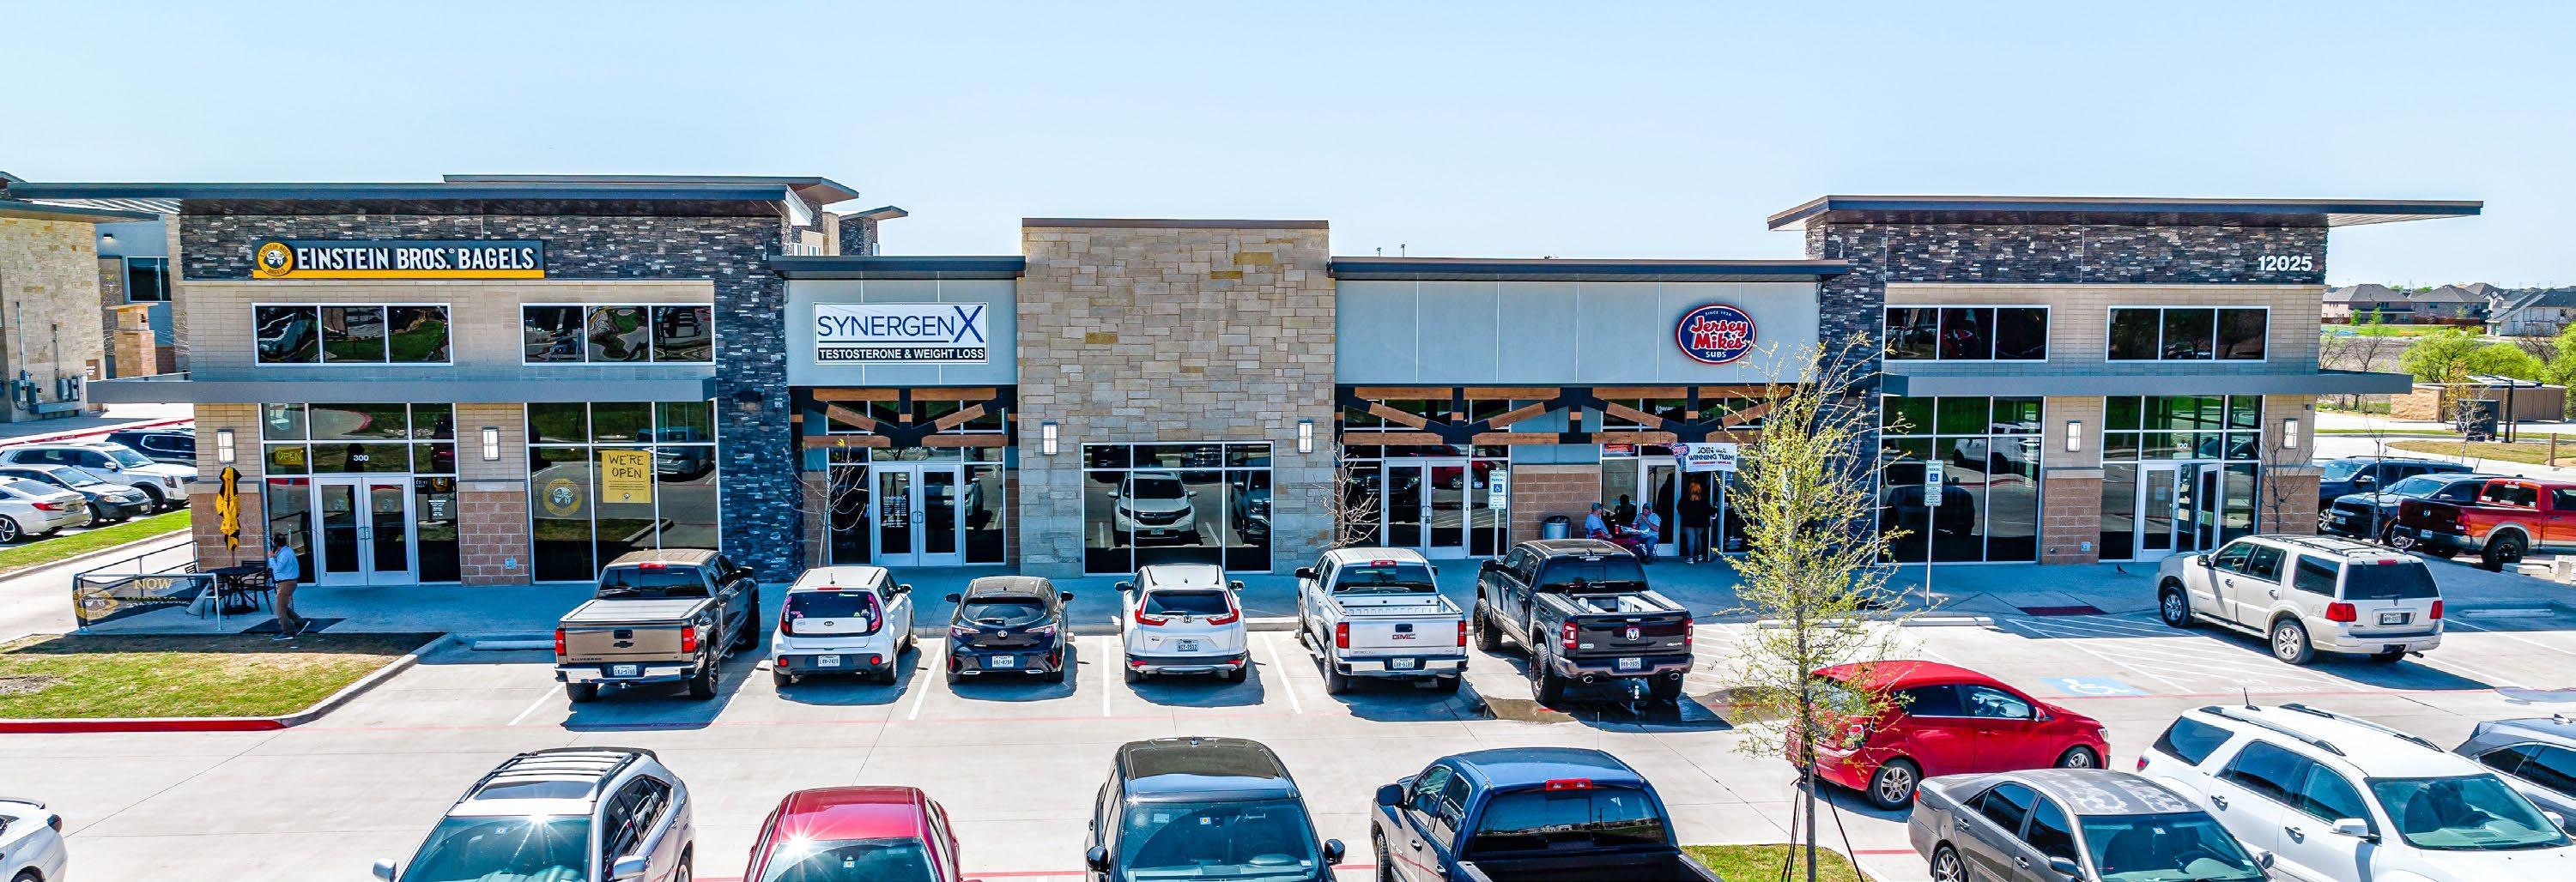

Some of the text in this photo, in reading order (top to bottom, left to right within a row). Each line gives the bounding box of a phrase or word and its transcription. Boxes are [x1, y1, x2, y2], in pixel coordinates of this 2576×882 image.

[297, 247, 389, 269] EINSTEIN
[458, 247, 534, 269] BAGELS
[2258, 255, 2312, 272] 12025
[817, 305, 985, 343] SYNERGENX
[1689, 316, 1749, 337] Jersey
[1693, 332, 1747, 350] Mike's
[819, 348, 985, 359] TESTOSTERONE & WEIGHT LOSS
[276, 450, 302, 462] OPEN
[609, 454, 644, 466] WE'RE
[612, 467, 642, 479] OPEN
[134, 578, 172, 590] NOW
